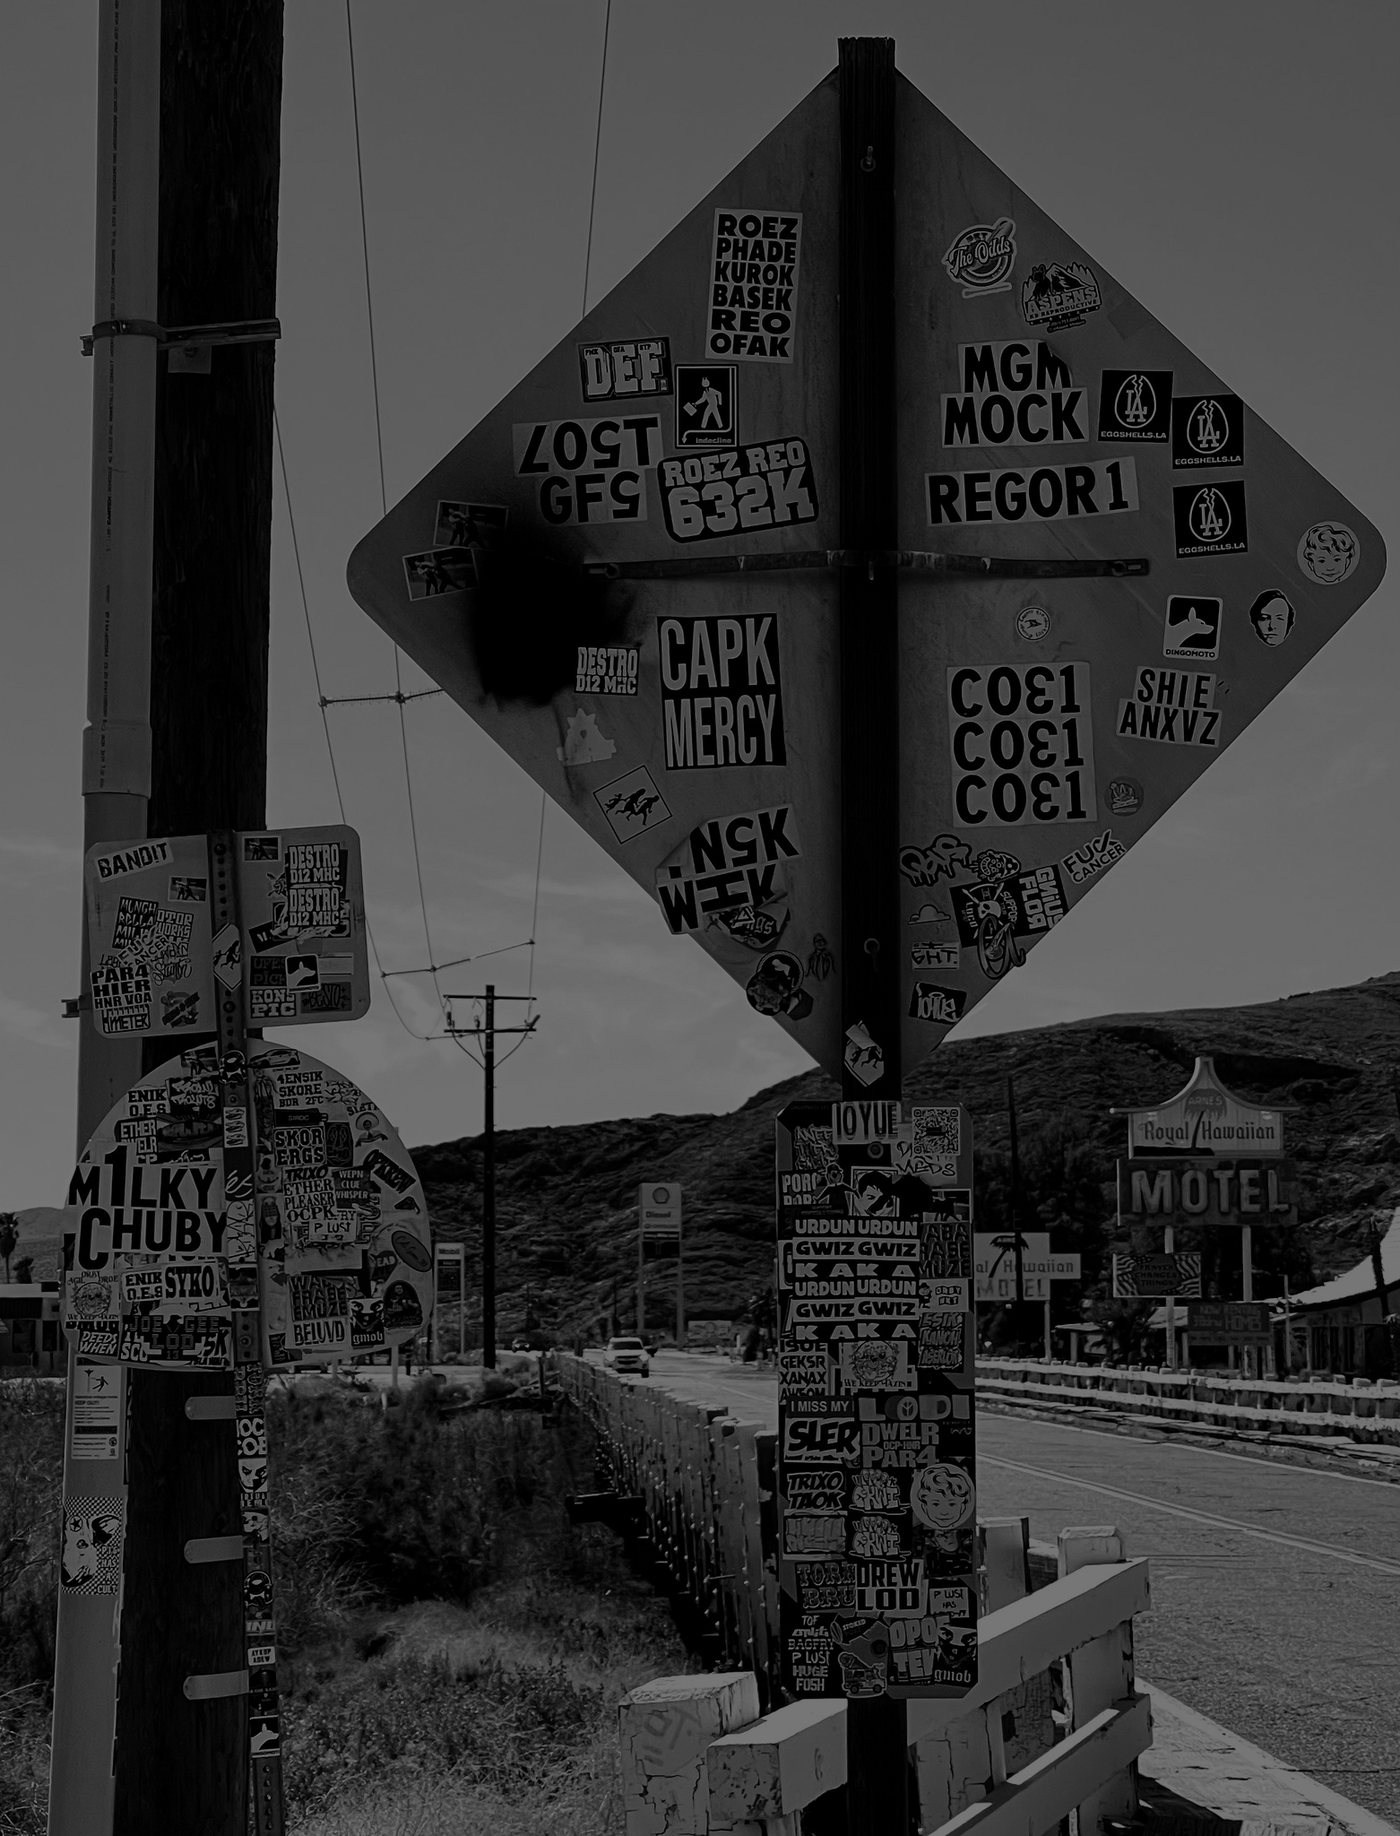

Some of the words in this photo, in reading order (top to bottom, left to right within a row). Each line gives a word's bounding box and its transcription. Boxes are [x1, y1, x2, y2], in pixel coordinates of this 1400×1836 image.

[718, 214, 798, 240] ROEZ
[717, 238, 796, 264] PHADE
[948, 245, 973, 278] The
[975, 235, 1011, 263] Odds
[715, 261, 794, 287] KUROK
[713, 284, 793, 312] BASEK
[1026, 286, 1097, 313] ASPENS
[1041, 299, 1097, 317] REPRODUCTIVE
[711, 309, 791, 334] REO
[710, 333, 790, 358] OFAK
[964, 342, 1071, 392] MGM
[944, 391, 1085, 445] MOCK
[1100, 430, 1167, 440] EGGSHELLS.LA
[663, 452, 742, 487] ROEZ
[746, 441, 807, 475] REO
[1175, 455, 1242, 465] EGGSHELLS.LA
[667, 466, 815, 538] 632K
[1178, 542, 1246, 554] EGGSHELLS.LA
[577, 647, 638, 677] DESTRO
[660, 617, 775, 691] CAPK
[1166, 649, 1215, 658] DINGOMOTO
[576, 676, 601, 692] D12
[1138, 669, 1211, 708] SHIE
[665, 694, 776, 767] MERCY
[1120, 701, 1219, 745] ANXVZ
[289, 844, 340, 869] DESTRO
[1072, 845, 1126, 883] CANCER
[313, 867, 340, 882] MHC
[289, 888, 340, 911] DESTRO
[1000, 891, 1018, 924] SUPPOR
[312, 911, 340, 925] MHC
[91, 965, 149, 984] PAR4
[93, 980, 151, 997] HIER
[95, 996, 121, 1009] HNR
[125, 992, 152, 1005] VOA
[252, 1003, 295, 1017] PIC
[279, 1084, 321, 1097] SKORE
[276, 1129, 322, 1148] SKOR
[1139, 1121, 1189, 1145] Royal
[1202, 1121, 1275, 1140] Hawaiian
[285, 1167, 327, 1181] TRIXO
[284, 1179, 333, 1196] ETHER
[1131, 1169, 1290, 1213] MOTEL
[285, 1192, 335, 1210] PLEASER
[795, 1219, 855, 1235] URDUN
[858, 1219, 918, 1236] URDUN
[79, 1208, 227, 1270] CHUBY
[796, 1241, 854, 1255] GWIZ
[858, 1242, 916, 1257] GWIZ
[1003, 1259, 1073, 1273] Hwaiian
[165, 1265, 214, 1299] SYKO
[795, 1281, 855, 1296] URDUN
[857, 1279, 917, 1296] URDUN
[796, 1302, 855, 1318] GWIZ
[858, 1301, 916, 1316] GWIZ
[129, 1316, 163, 1333] JOE
[184, 1316, 220, 1333] GEE
[82, 1332, 118, 1344] DEEDS
[352, 1332, 383, 1345] gmob
[80, 1342, 117, 1355] WHEN
[779, 1371, 827, 1387] XANAX
[797, 1401, 829, 1412] MISS
[831, 1401, 850, 1412] MY
[862, 1445, 940, 1468] PAR4
[788, 1472, 843, 1490] TRIXO
[857, 1563, 919, 1587] DREW
[858, 1588, 919, 1611] LOD
[793, 1665, 828, 1677] HUGE
[934, 1669, 971, 1683] gmob
